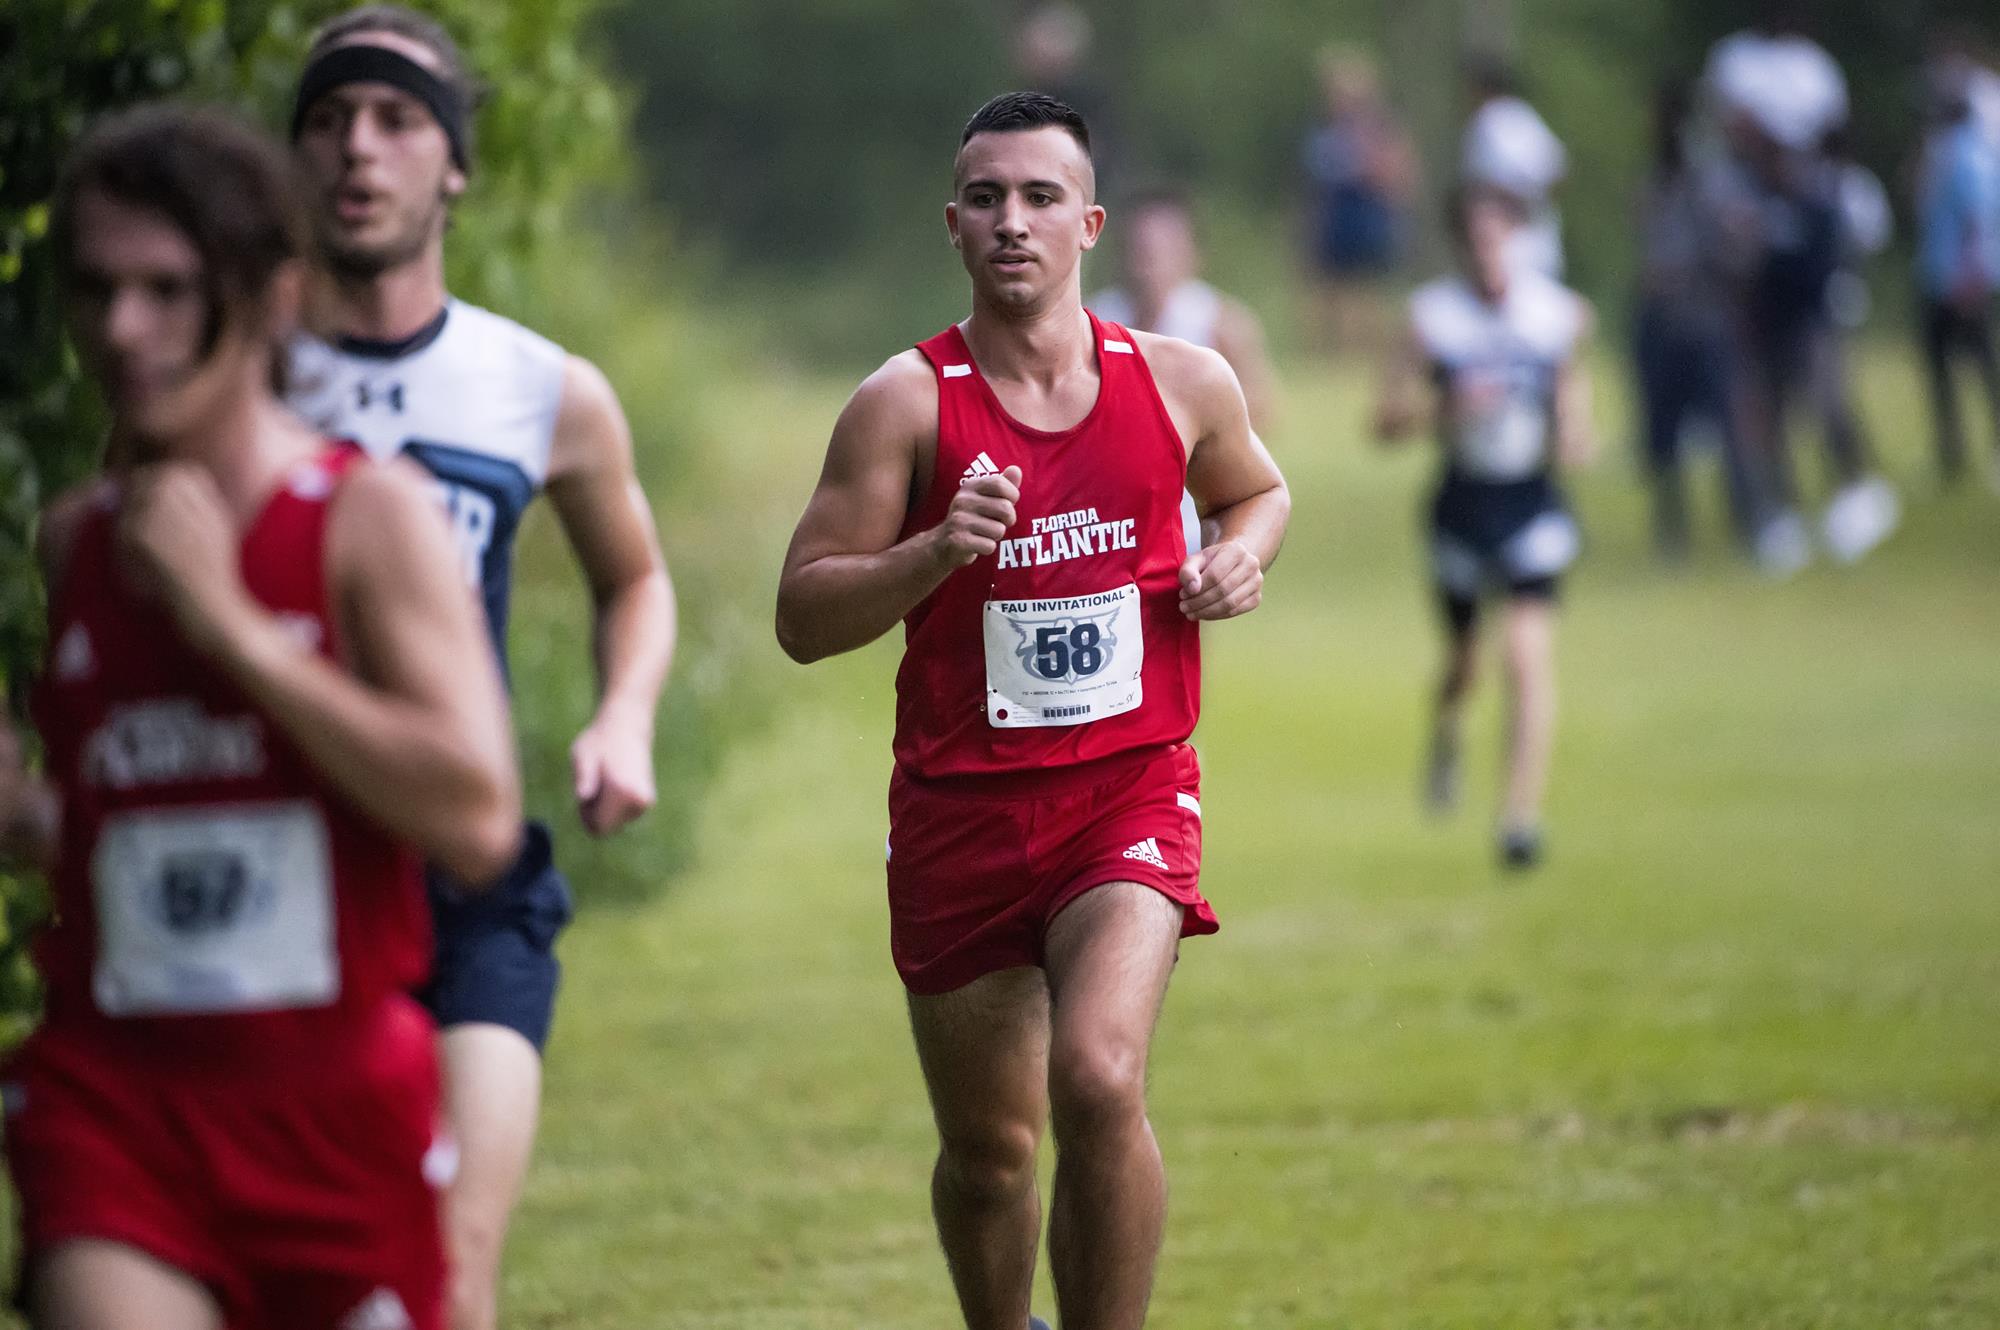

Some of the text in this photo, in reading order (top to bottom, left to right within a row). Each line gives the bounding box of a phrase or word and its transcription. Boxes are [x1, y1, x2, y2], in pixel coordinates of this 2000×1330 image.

[1032, 507, 1100, 535] FLORIDA
[997, 518, 1137, 570] ATLANTIC
[1001, 590, 1126, 613] FAU INVITATIONAL
[1035, 623, 1102, 679] 58
